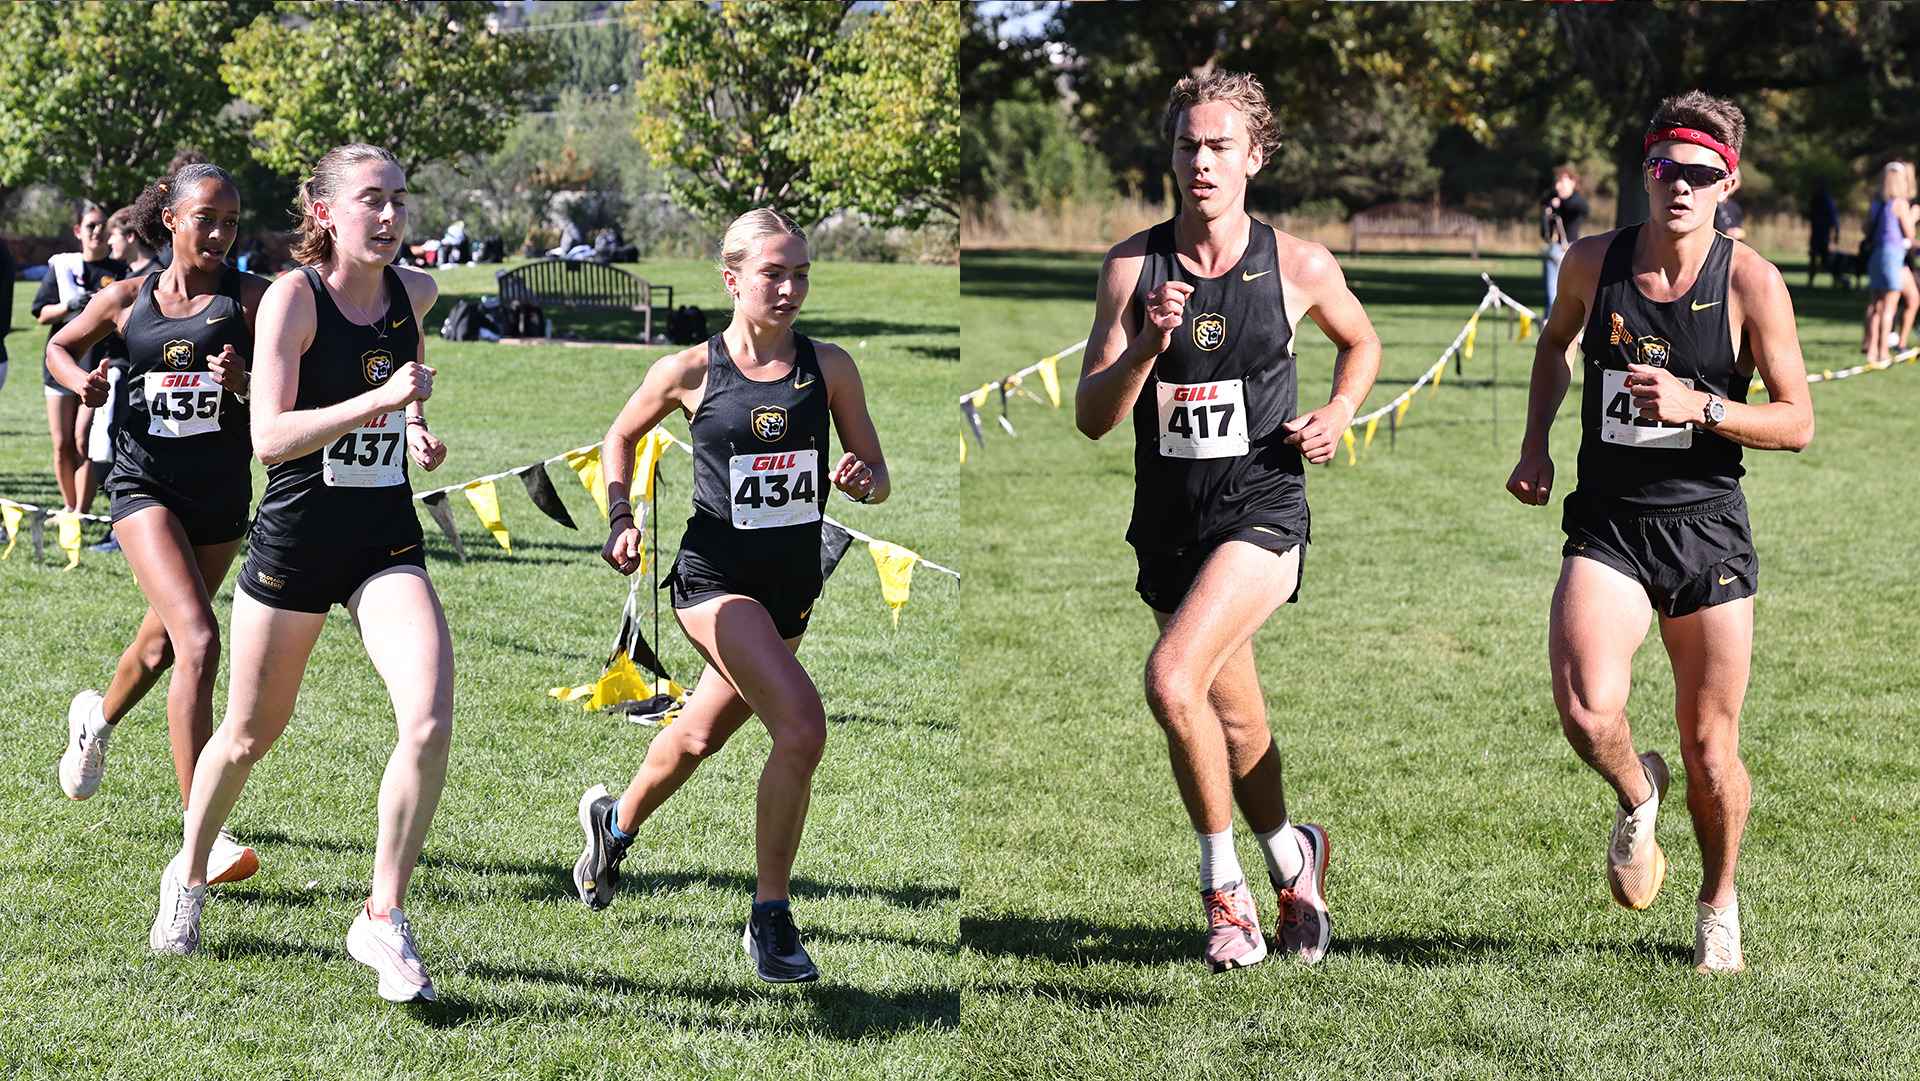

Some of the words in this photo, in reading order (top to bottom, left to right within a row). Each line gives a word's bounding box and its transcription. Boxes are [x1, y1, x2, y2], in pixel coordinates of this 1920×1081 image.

[161, 375, 201, 387] GILL
[1174, 385, 1219, 402] GILL
[151, 391, 218, 421] 435
[360, 413, 389, 428] ILL
[1168, 403, 1235, 439] 417
[328, 432, 400, 467] 437
[752, 454, 796, 471] GILL
[734, 471, 816, 509] 434
